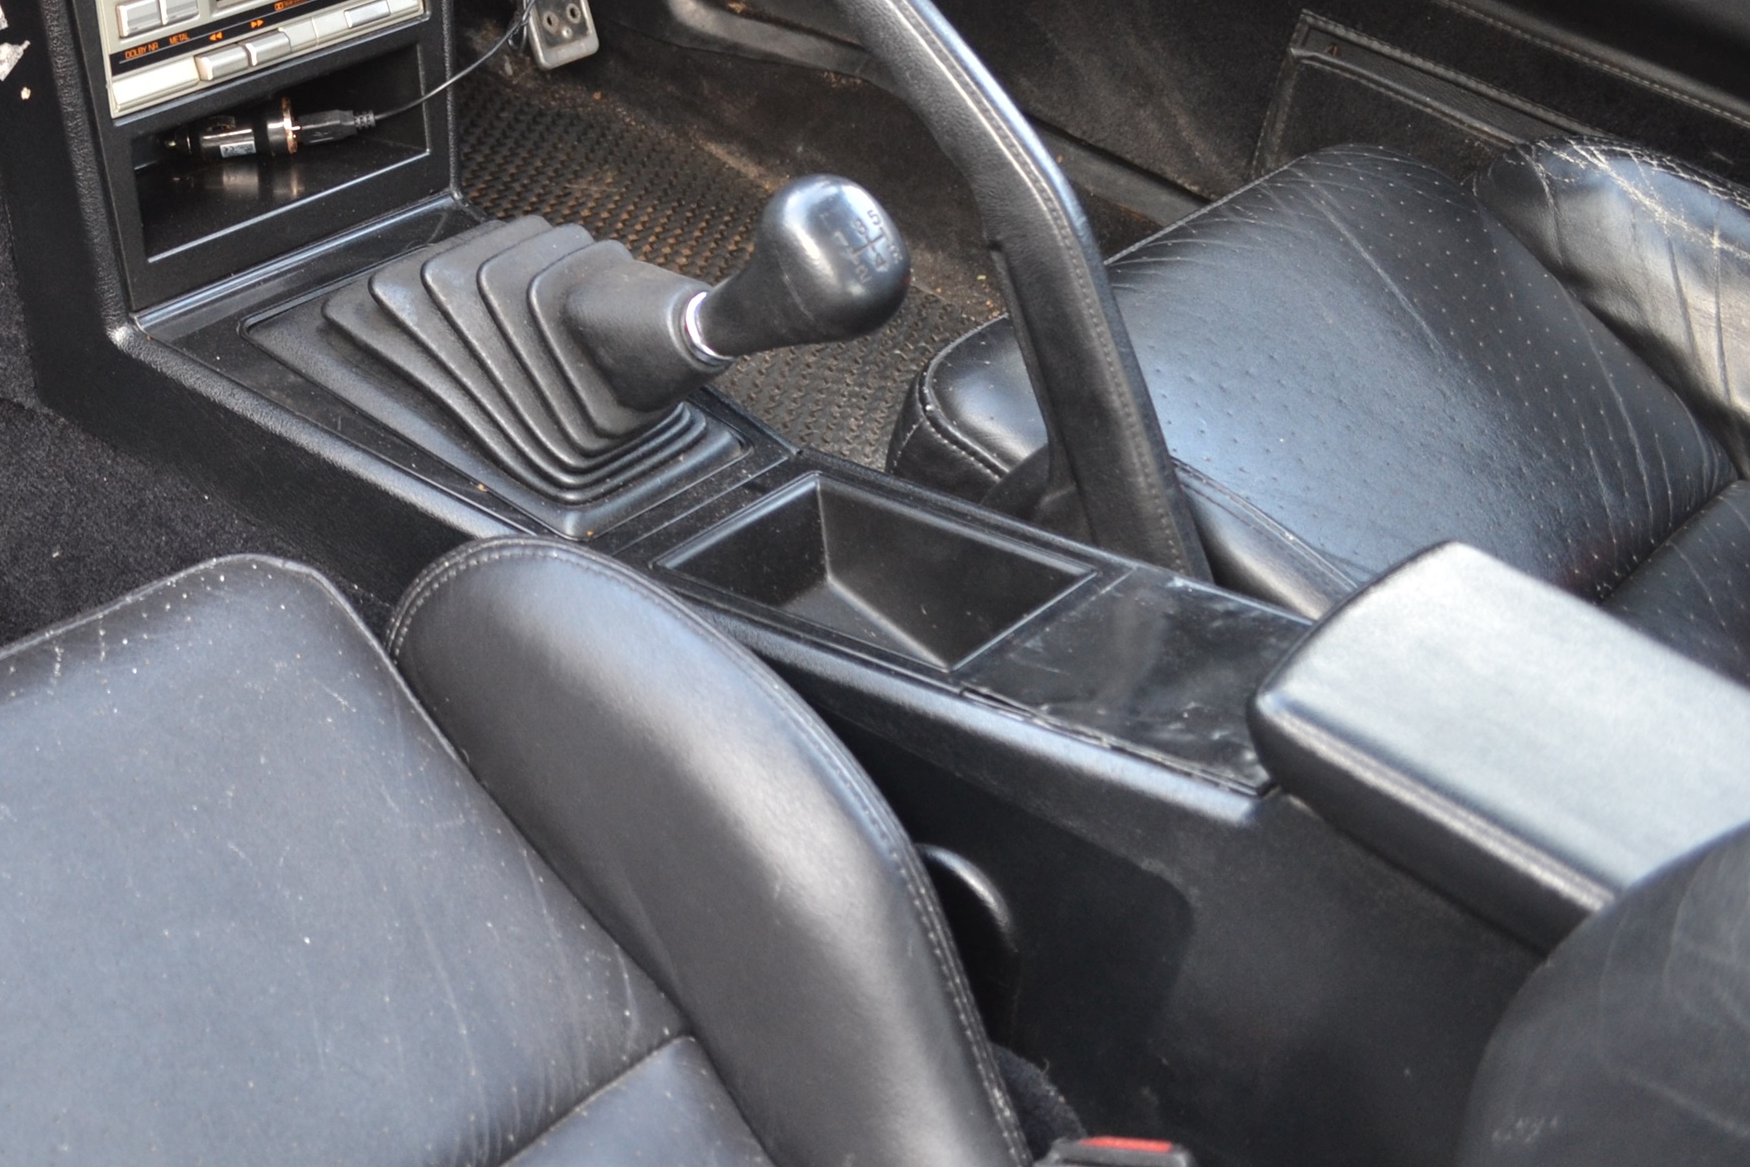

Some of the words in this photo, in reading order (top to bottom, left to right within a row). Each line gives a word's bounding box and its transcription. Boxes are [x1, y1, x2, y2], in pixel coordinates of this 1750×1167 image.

[169, 32, 190, 45] METAL
[125, 45, 148, 60] DOLBY
[148, 41, 159, 51] NR
[867, 209, 882, 226] 5
[851, 218, 867, 236] 3
[875, 252, 889, 272] 4
[856, 265, 873, 284] 2
